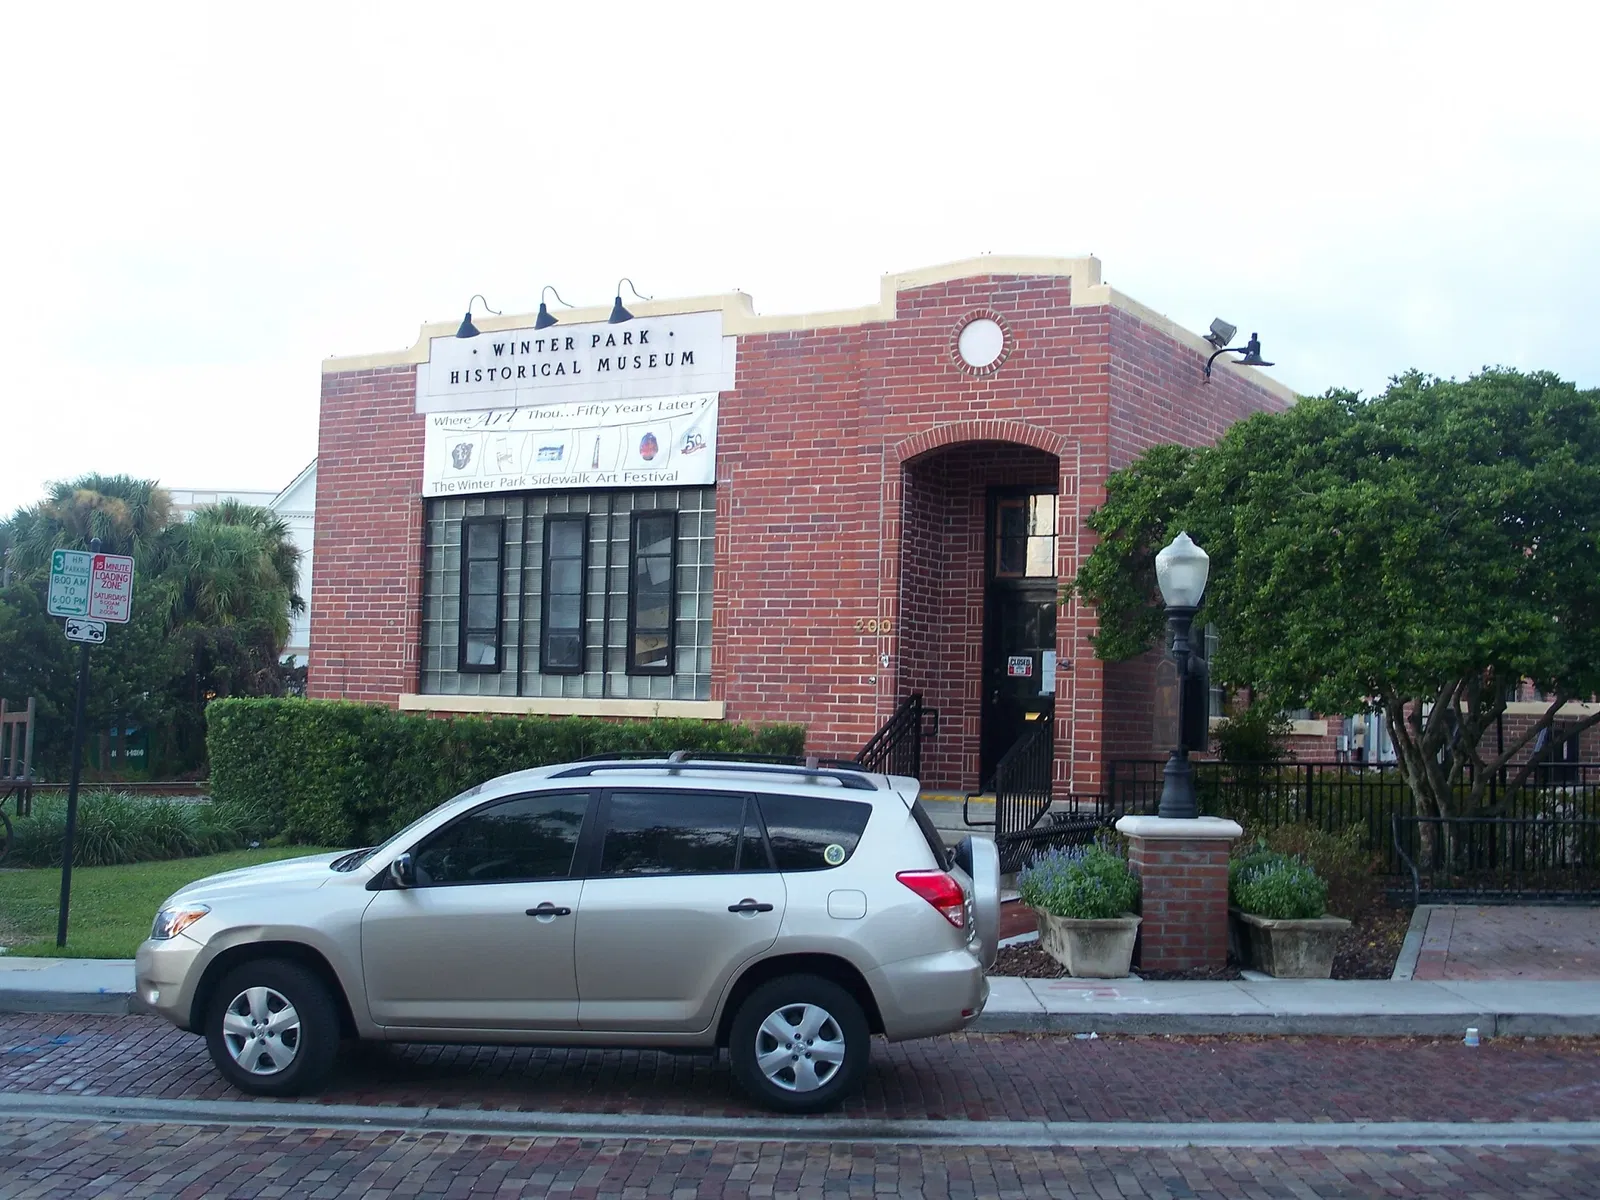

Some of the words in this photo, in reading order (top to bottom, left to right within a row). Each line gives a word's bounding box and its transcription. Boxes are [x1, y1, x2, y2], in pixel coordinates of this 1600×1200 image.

[493, 336, 575, 357] WINTER
[591, 330, 650, 348] PARK
[450, 360, 581, 384] HISTORICAL
[597, 351, 695, 372] MUSEUM
[434, 415, 472, 426] Where
[614, 403, 653, 414] Years
[658, 400, 696, 411] Later
[432, 481, 455, 493] The
[457, 479, 496, 491] Winter
[500, 476, 526, 488] Park
[531, 473, 590, 486] Sidewalk
[595, 473, 619, 483] Art
[624, 470, 679, 483] Festival
[54, 555, 64, 570] 3
[72, 556, 84, 564] HR
[54, 575, 71, 585] 8:00
[73, 578, 87, 587] AM
[95, 572, 128, 582] LOADING
[101, 580, 122, 590] ZONE
[64, 586, 75, 596] TO
[52, 595, 71, 605] 6:00
[73, 597, 86, 606] PM
[94, 592, 127, 602] SATURDAYS
[1010, 658, 1031, 666] CLOSED
